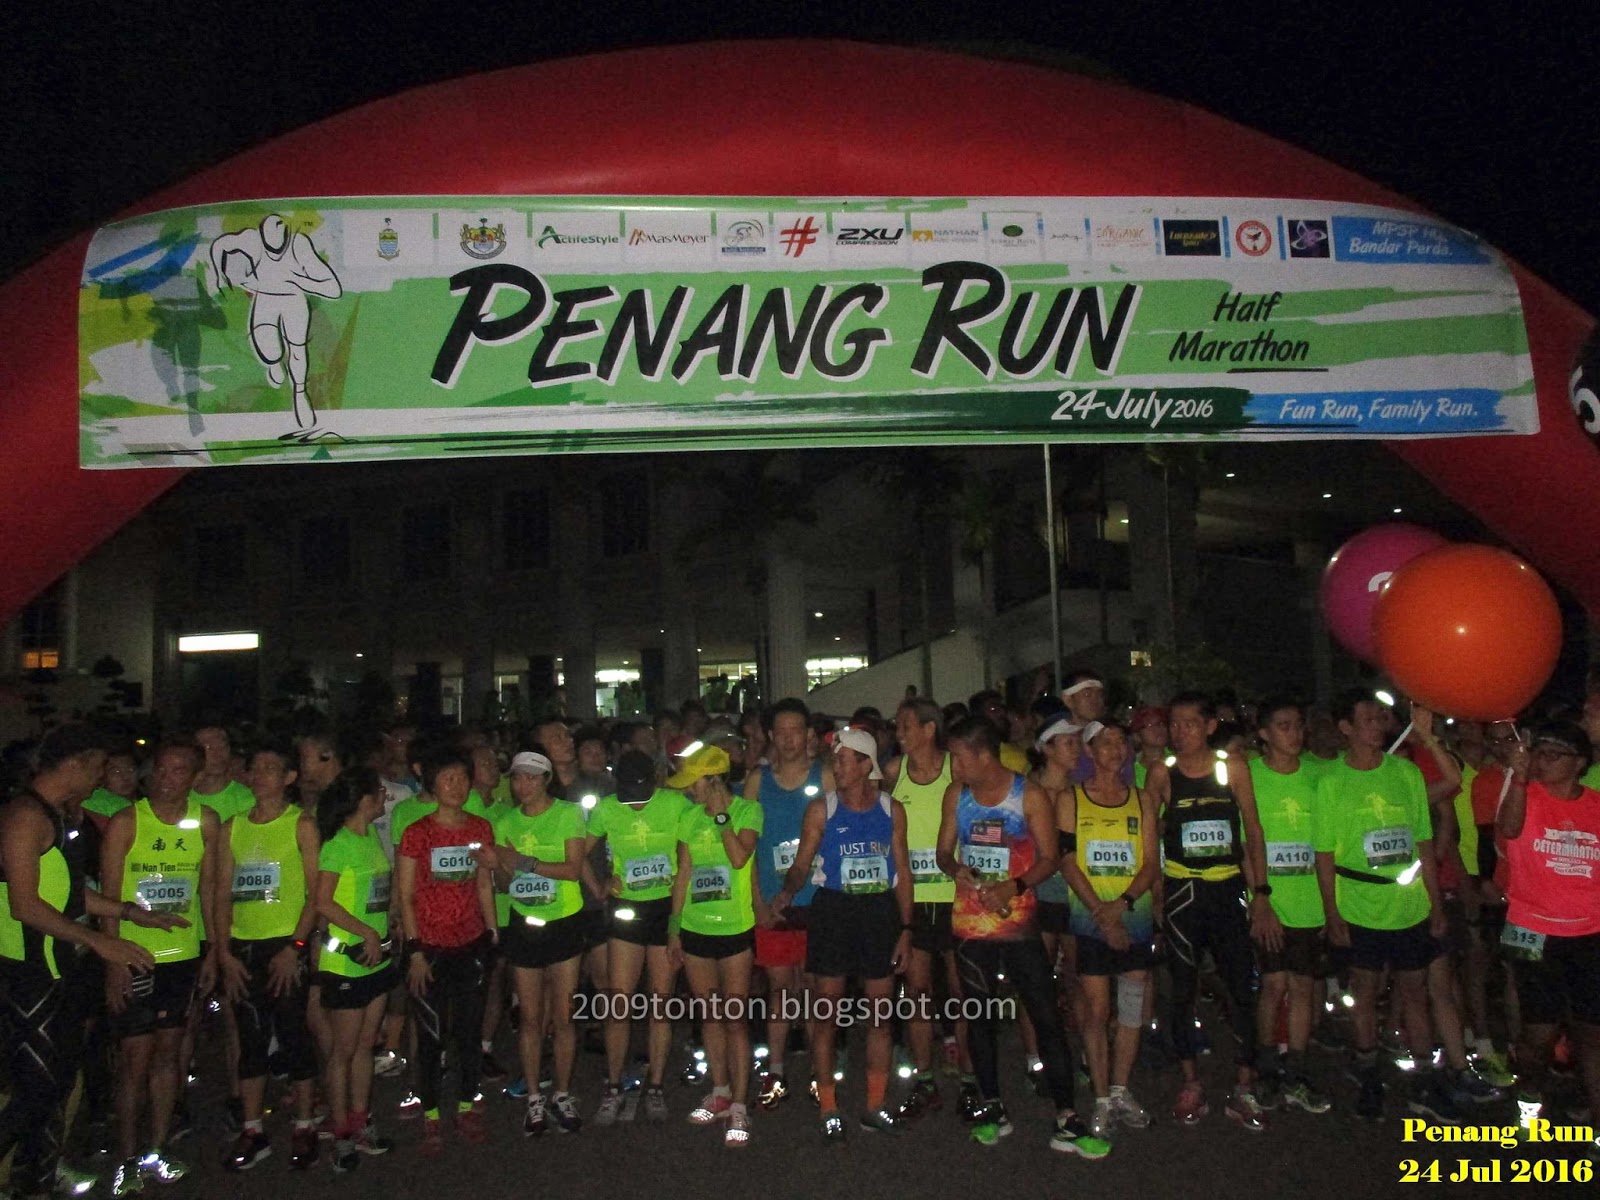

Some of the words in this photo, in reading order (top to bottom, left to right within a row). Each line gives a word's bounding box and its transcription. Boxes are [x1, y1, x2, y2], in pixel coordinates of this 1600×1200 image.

[837, 228, 904, 240] 2XU
[1349, 237, 1403, 254] Bandar
[1213, 291, 1282, 322] Half
[431, 262, 892, 388] PENANG
[911, 261, 1143, 382] RUN
[1169, 330, 1309, 363] Marathon
[1172, 398, 1214, 419] 2016
[1279, 399, 1316, 419] Fun
[1321, 398, 1364, 421] Run,
[1368, 397, 1431, 424] Family
[1436, 397, 1480, 418] Run.
[1189, 831, 1225, 842] D018
[839, 842, 866, 856] JUST
[1371, 838, 1407, 852] D073
[439, 856, 473, 868] G010
[967, 855, 1002, 869] D313
[1093, 851, 1128, 862] D016
[1275, 852, 1309, 863] A110
[142, 863, 158, 872] Nan
[160, 863, 176, 872] Tien
[632, 864, 665, 877] G047
[911, 859, 936, 870] D01
[848, 866, 881, 879] D017
[237, 874, 272, 887] D088
[515, 881, 549, 893] G046
[696, 876, 725, 889] G045
[146, 887, 185, 899] D005
